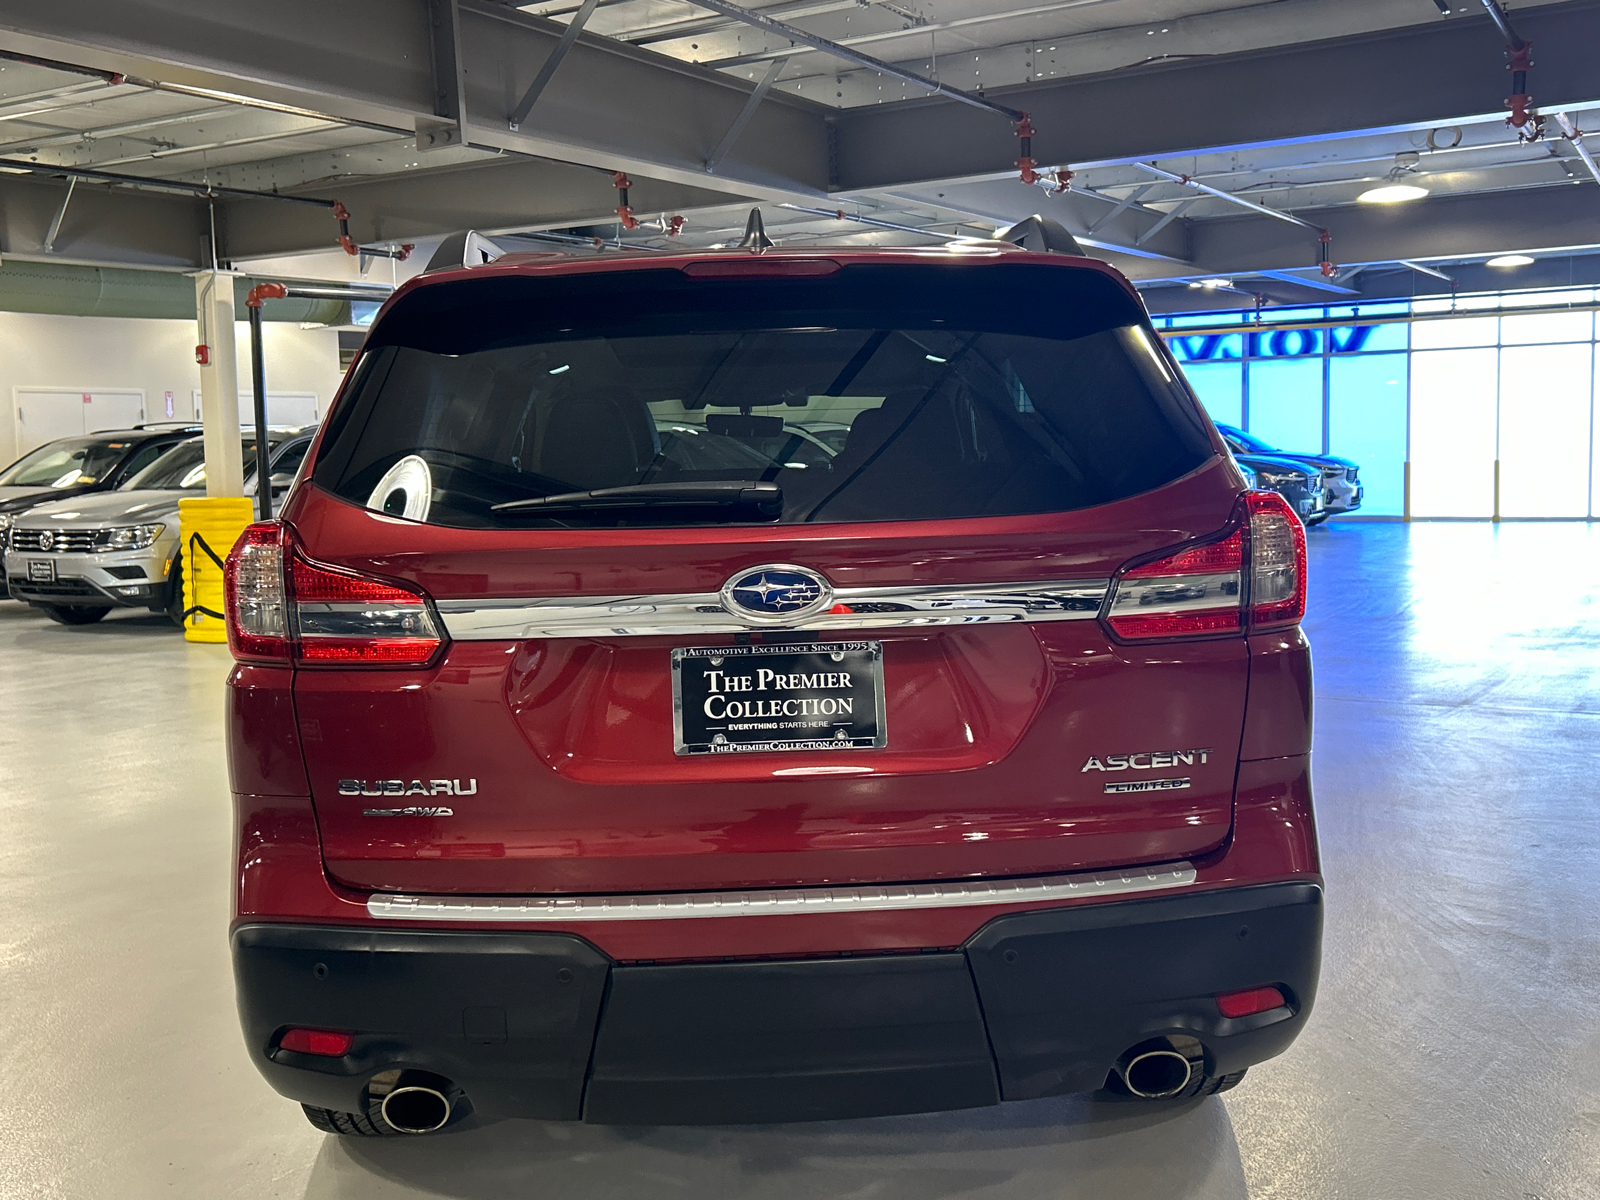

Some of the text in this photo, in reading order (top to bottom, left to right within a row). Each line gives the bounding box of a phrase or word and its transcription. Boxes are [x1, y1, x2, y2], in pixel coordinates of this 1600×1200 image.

[687, 642, 868, 656] AUTOMOTIVE EXCELLENCE SINCE 1995
[703, 669, 853, 693] THE PREMIER
[703, 695, 854, 719] COLLECTION
[728, 722, 778, 731] EVERYTHING
[779, 721, 807, 729] STARTS
[1080, 748, 1214, 772] ASCENT
[338, 778, 477, 796] SUBARU
[1115, 780, 1184, 792] LIMITED
[401, 806, 454, 817] AWD
